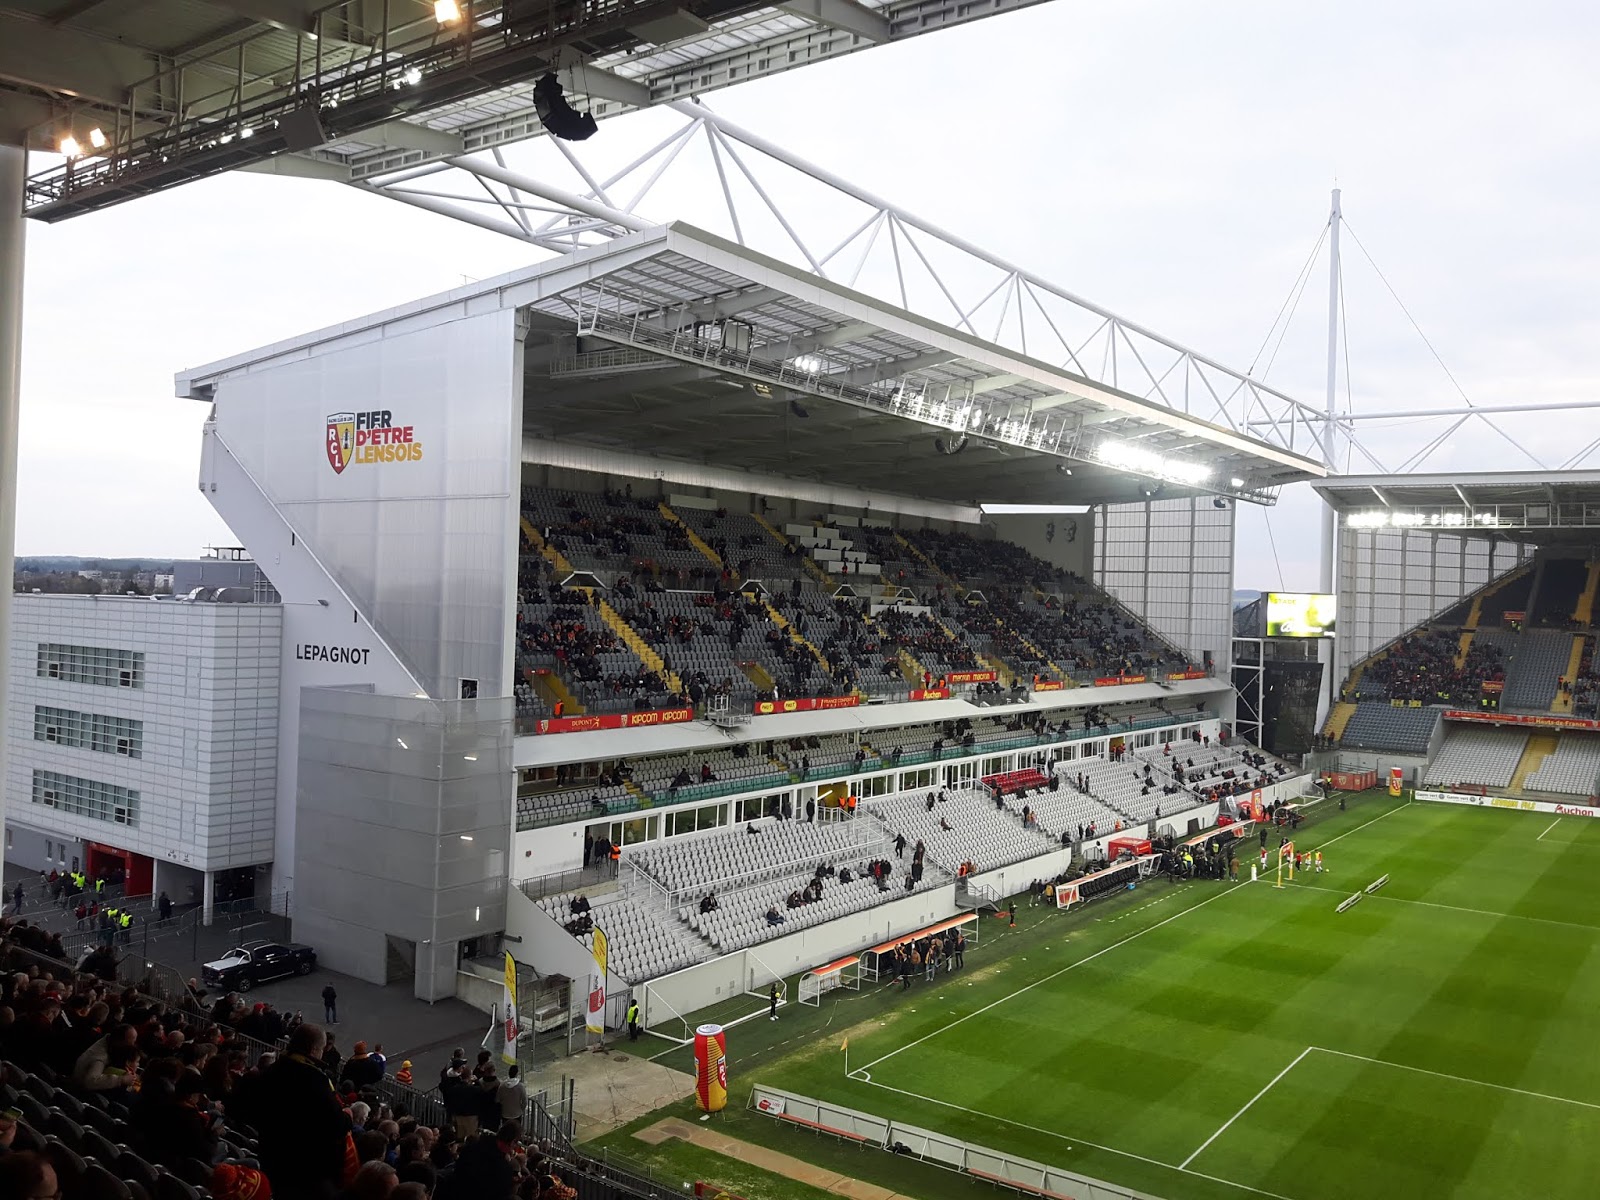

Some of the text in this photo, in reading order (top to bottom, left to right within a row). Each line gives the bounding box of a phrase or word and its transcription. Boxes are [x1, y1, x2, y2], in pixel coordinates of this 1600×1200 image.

[356, 410, 392, 430] FIER
[355, 425, 413, 446] D'ÊTRE
[355, 442, 422, 464] LENSOIS
[296, 644, 370, 665] LEPAGNOT
[923, 690, 941, 699] Auchan
[571, 719, 593, 727] DUPONT
[631, 710, 688, 724] KIPCOM KIPCOM
[1535, 718, 1587, 728] Hauts-de-France
[1554, 804, 1594, 817] Auchan
